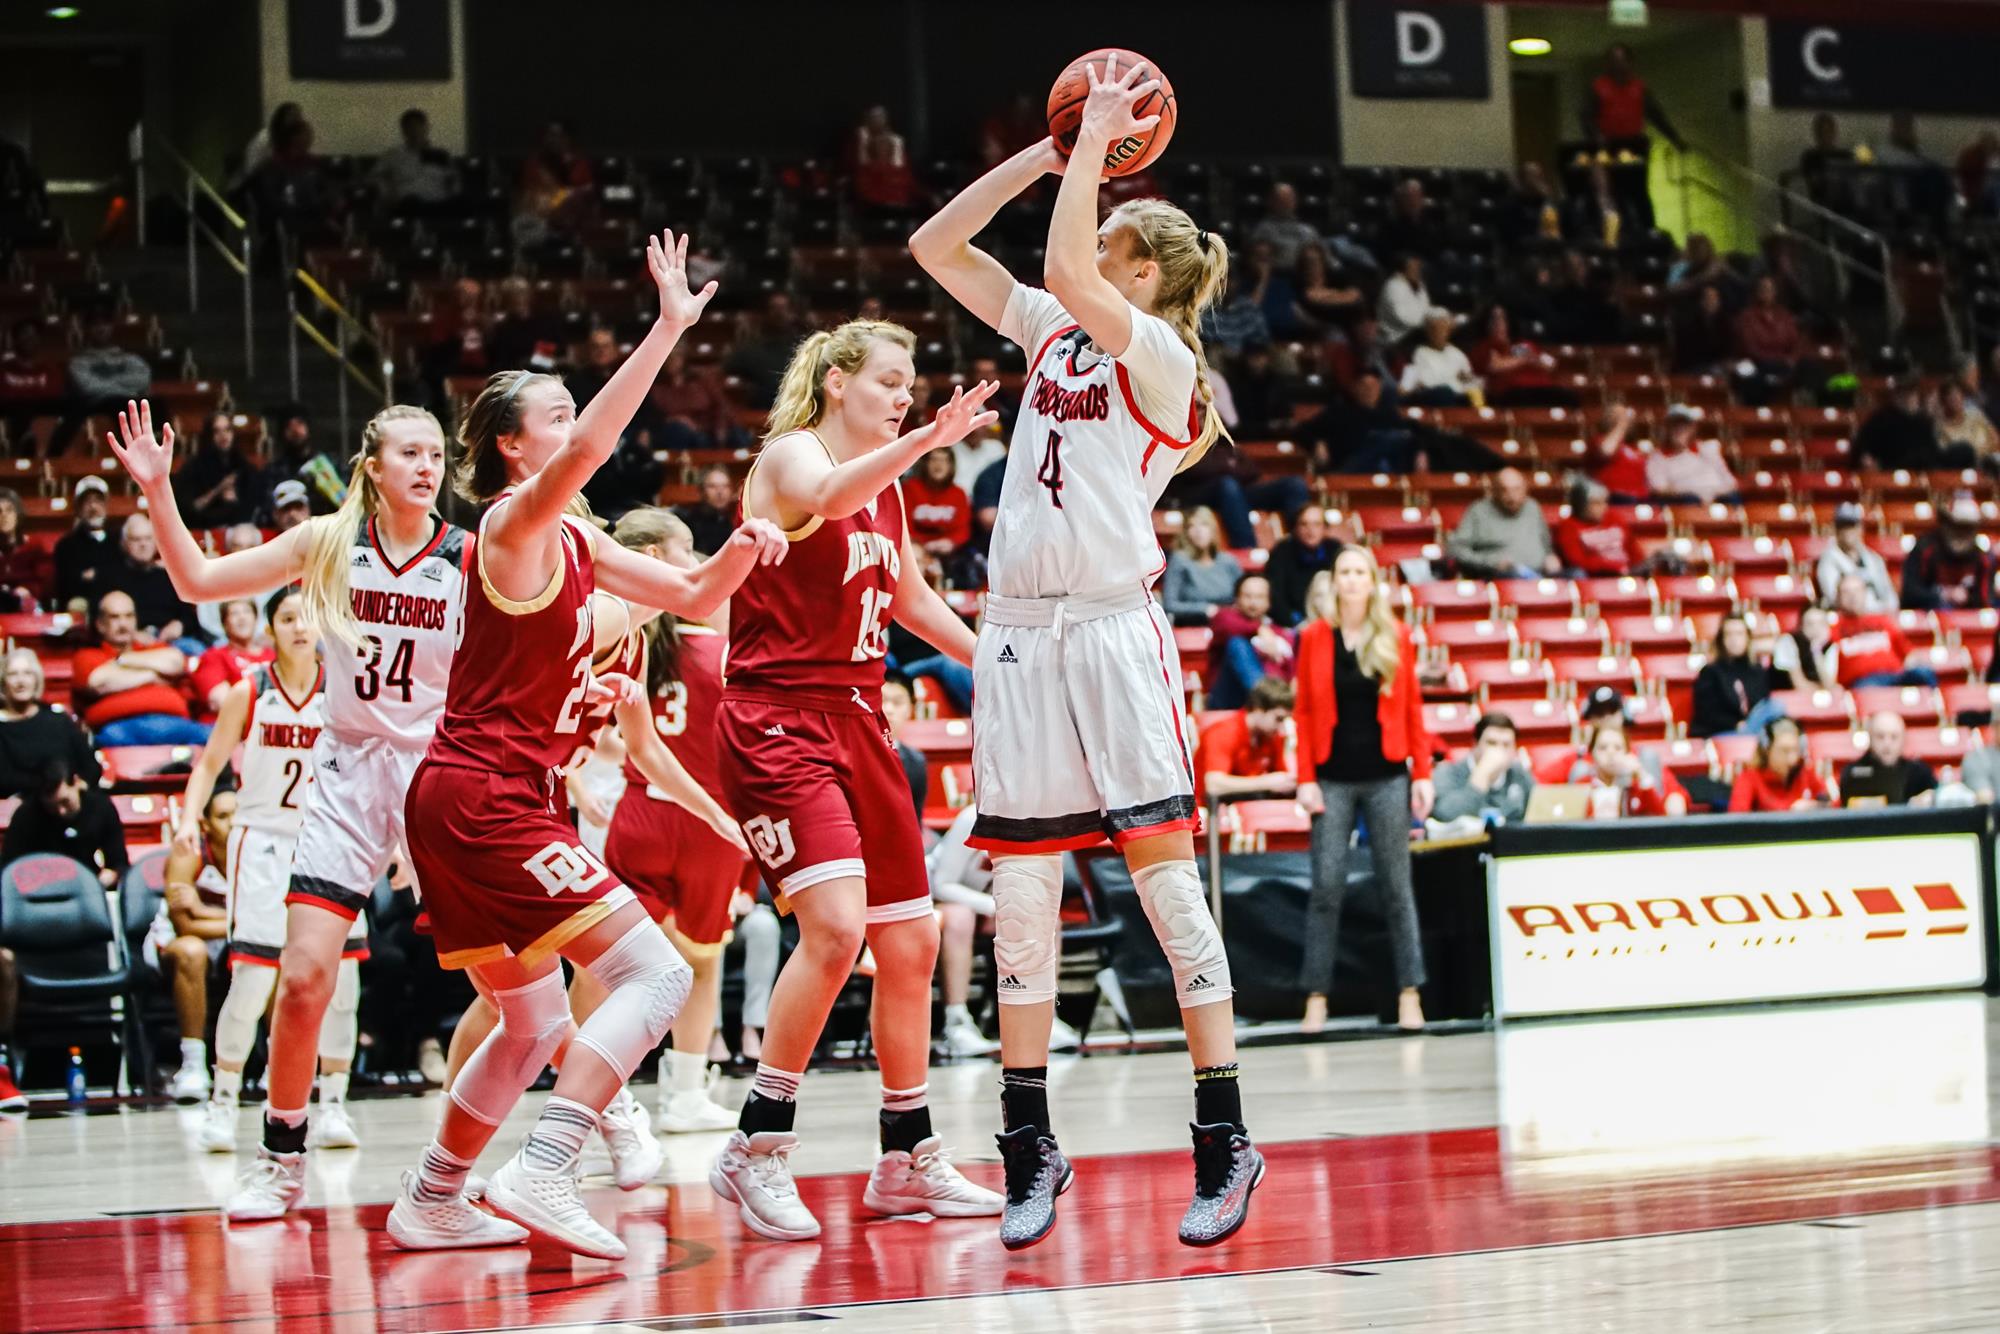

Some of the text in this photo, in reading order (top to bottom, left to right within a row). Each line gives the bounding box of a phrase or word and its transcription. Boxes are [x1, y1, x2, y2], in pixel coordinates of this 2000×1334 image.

[344, 0, 396, 38] D
[1396, 11, 1443, 65] D
[1803, 28, 1841, 79] C
[1038, 428, 1063, 509] 4
[349, 587, 447, 631] HUNDERBIRDS
[851, 586, 893, 662] 15
[355, 635, 415, 702] 34
[655, 681, 687, 736] 3
[280, 759, 302, 809] 2
[522, 841, 609, 898] DU
[1506, 890, 1843, 936] ARROW
[1185, 982, 1215, 992] adidas
